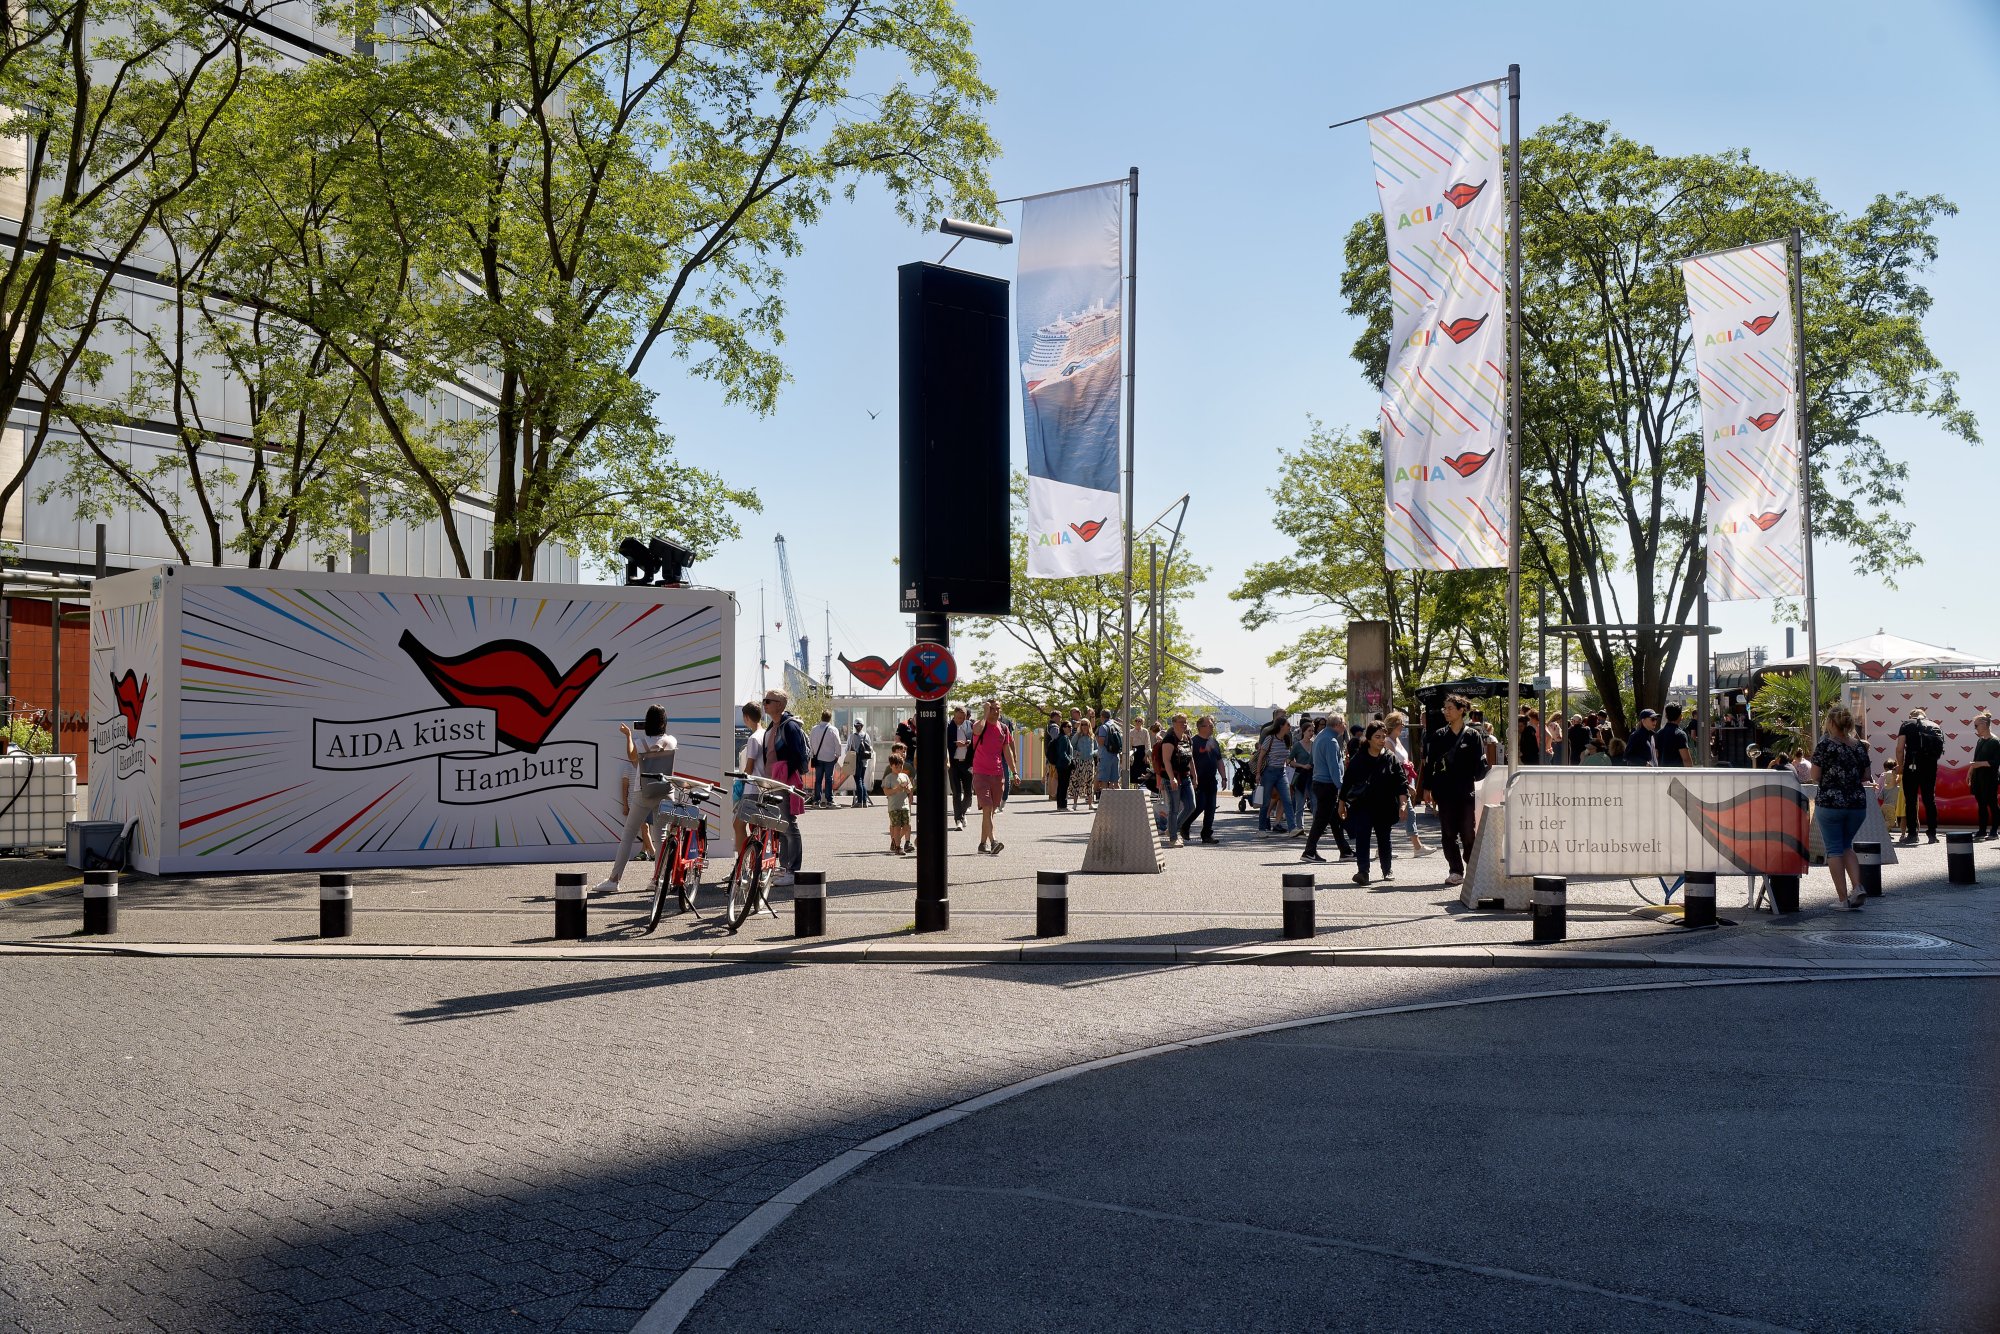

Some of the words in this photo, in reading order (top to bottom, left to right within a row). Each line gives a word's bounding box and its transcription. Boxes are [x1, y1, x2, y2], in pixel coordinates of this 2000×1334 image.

[1893, 667, 1937, 681] AIDA
[99, 729, 111, 746] AIDA
[112, 722, 127, 740] küsst
[326, 728, 404, 758] AIDA
[413, 718, 486, 746] küsst
[119, 749, 143, 770] Hamburg
[454, 755, 584, 792] Hamburg
[1519, 793, 1624, 807] Willkommen
[1519, 816, 1533, 830] in
[1539, 816, 1566, 830] der
[1519, 839, 1560, 853] AIDA
[1565, 839, 1662, 853] Urlaubswelt
